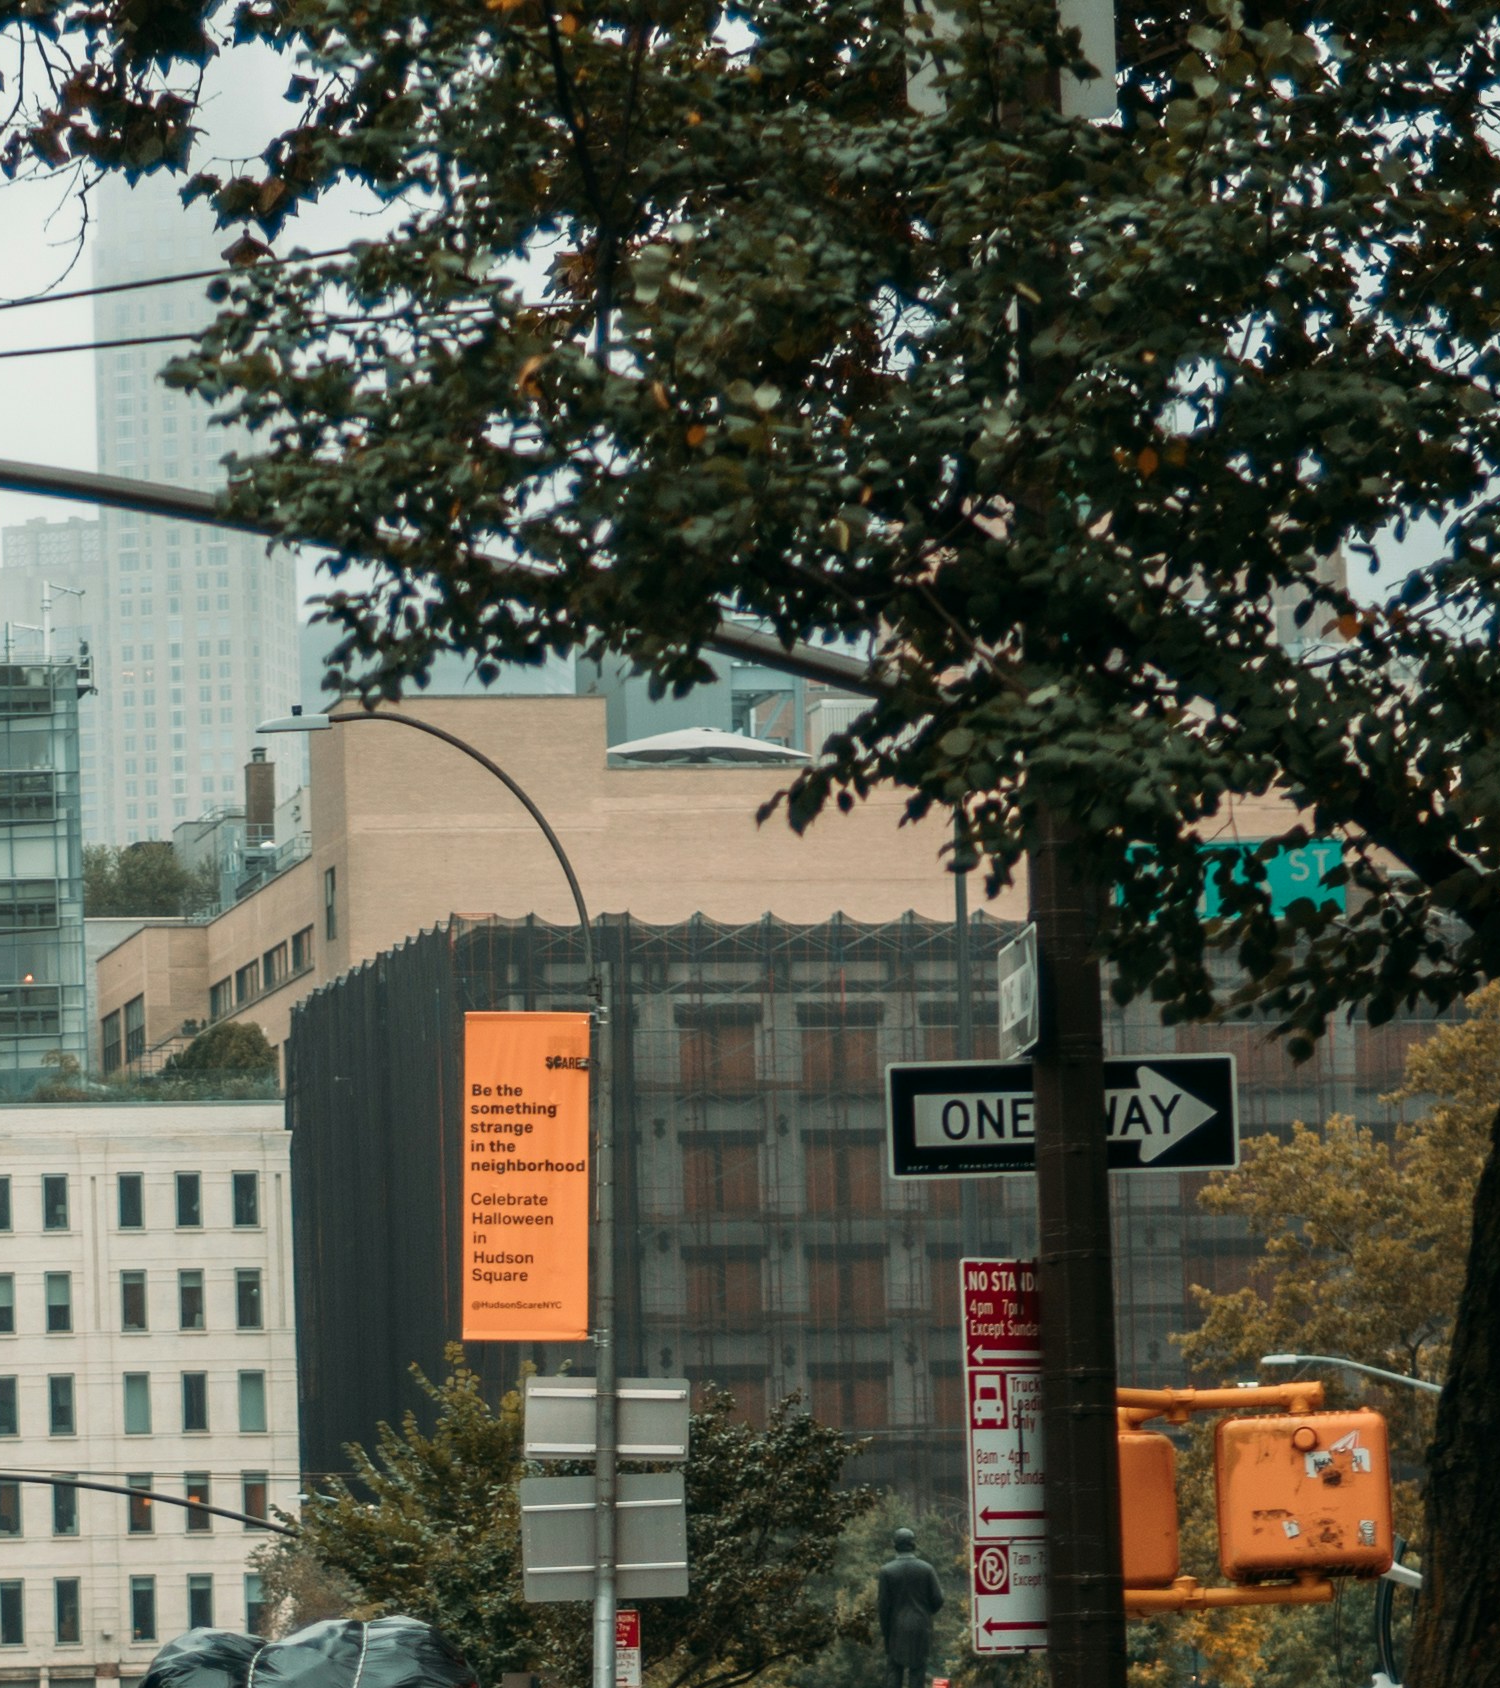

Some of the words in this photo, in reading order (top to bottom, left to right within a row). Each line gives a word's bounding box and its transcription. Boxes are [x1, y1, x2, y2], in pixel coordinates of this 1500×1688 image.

[1288, 848, 1332, 882] ST
[472, 1083, 492, 1097] Be
[496, 1084, 523, 1097] the
[471, 1102, 557, 1118] something
[470, 1121, 534, 1136] strange
[941, 1099, 1034, 1141] ONE
[471, 1139, 485, 1152] in
[489, 1139, 516, 1153] the
[471, 1158, 586, 1175] neighborhood
[471, 1192, 548, 1206] Celebrate
[472, 1212, 554, 1226] Halloween
[473, 1231, 487, 1244] in
[473, 1250, 534, 1265] Hudson
[472, 1268, 529, 1285] Square
[968, 1270, 988, 1292] NO
[471, 1300, 562, 1311] @HudsonScareNYC
[970, 1299, 994, 1318] 4pm
[971, 1319, 1005, 1340] Except
[1007, 1319, 1039, 1337] Sunda
[1011, 1376, 1042, 1393] Truck
[976, 1448, 999, 1465] 8am
[976, 1469, 1012, 1488] Except
[1014, 1468, 1046, 1486] Sunda
